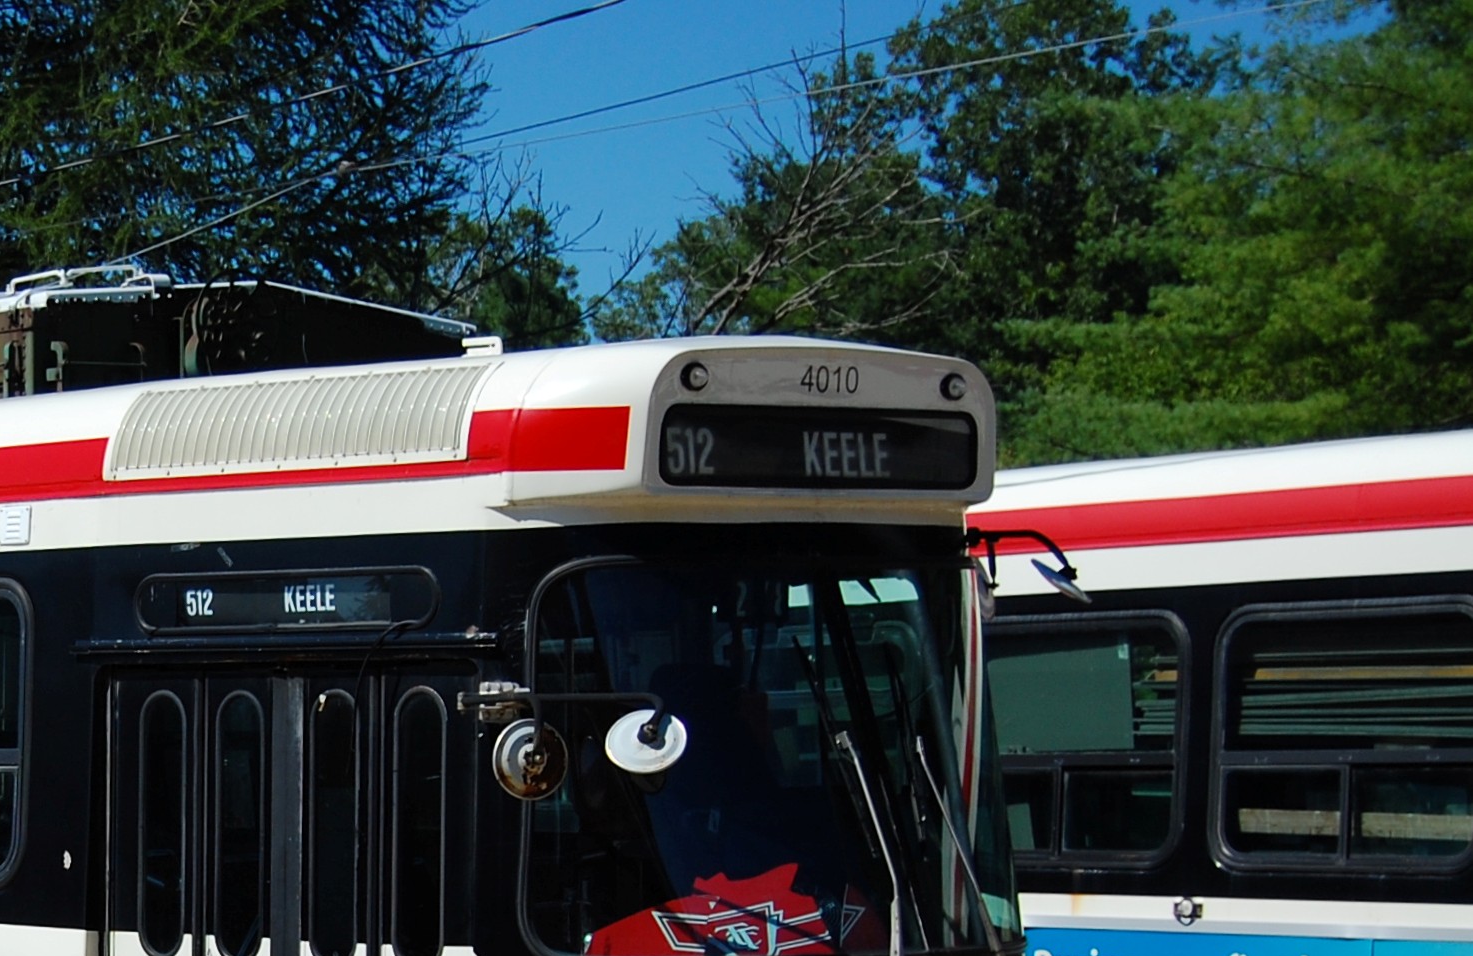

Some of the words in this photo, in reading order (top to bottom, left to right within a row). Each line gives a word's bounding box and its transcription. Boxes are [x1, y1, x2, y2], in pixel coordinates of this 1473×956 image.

[799, 365, 860, 395] 4010
[665, 426, 716, 475] 512
[802, 430, 892, 478] KEELE
[185, 588, 214, 617] 512
[283, 583, 337, 613] KEELE
